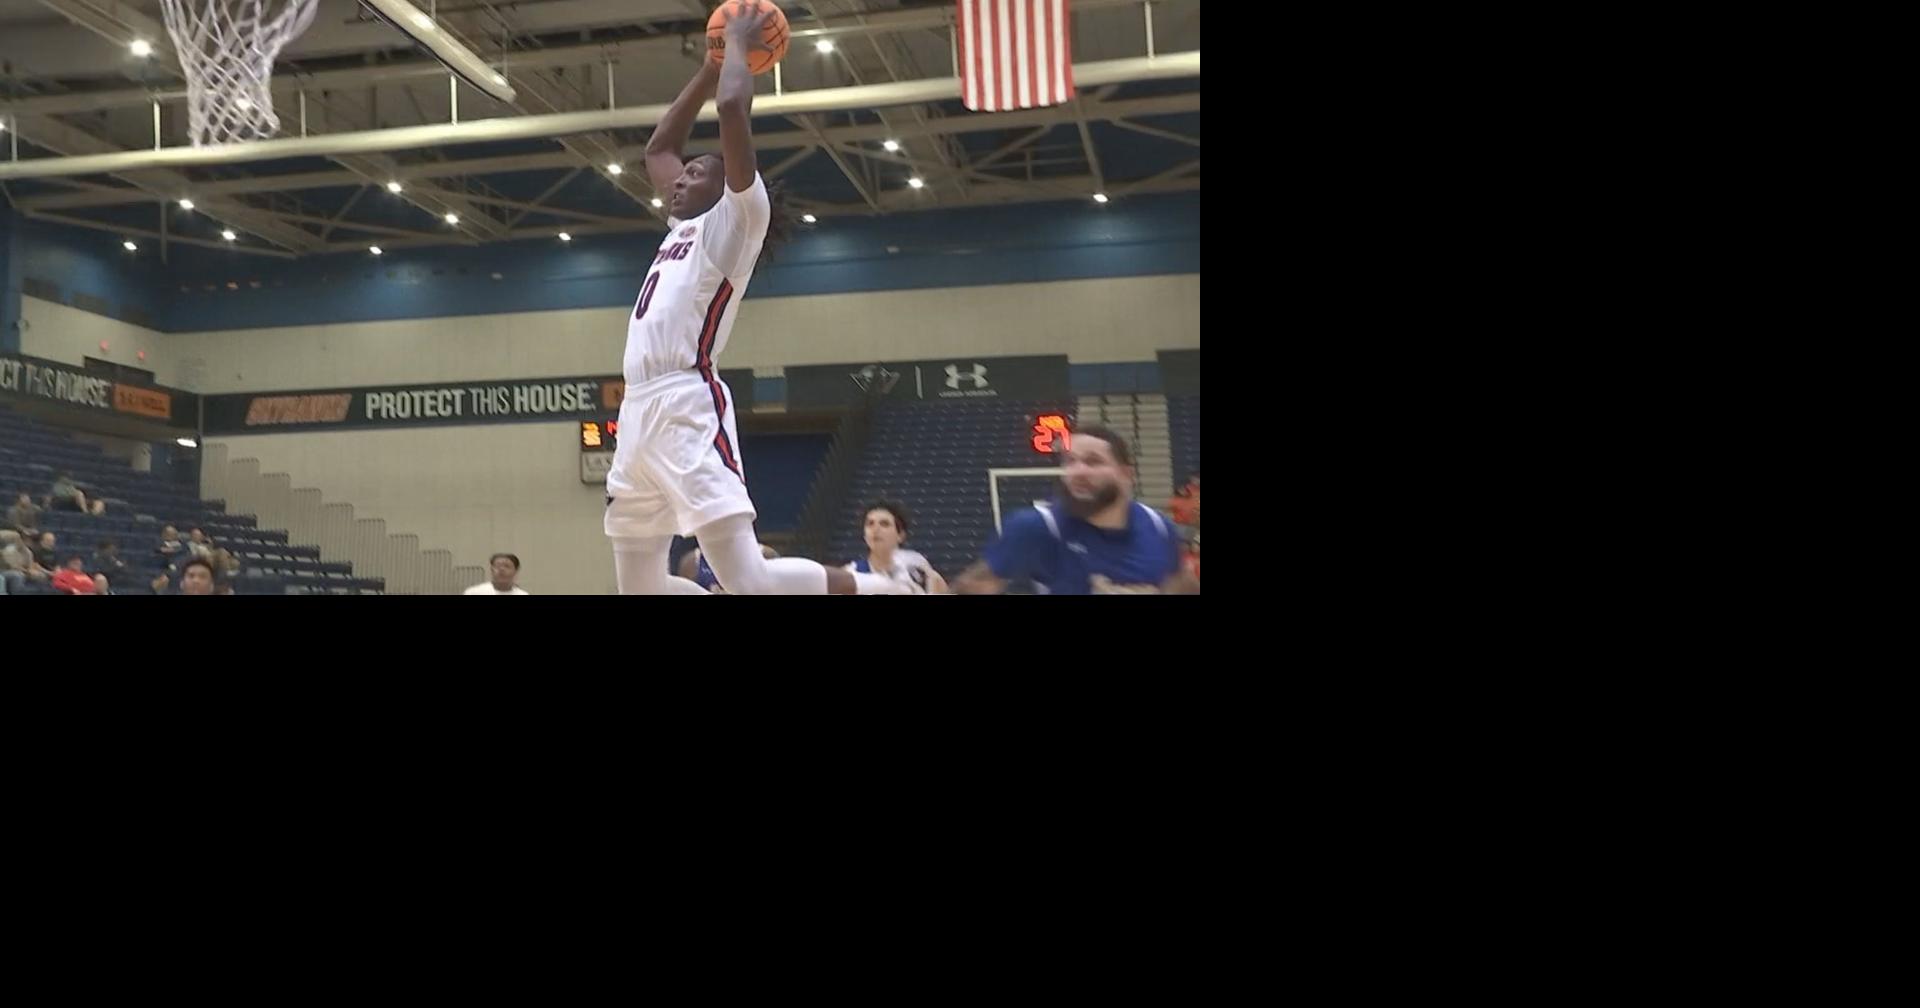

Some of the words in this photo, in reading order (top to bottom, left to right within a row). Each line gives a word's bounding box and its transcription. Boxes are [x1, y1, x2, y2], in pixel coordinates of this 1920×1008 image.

[636, 271, 660, 320] 0
[365, 389, 466, 420] PROTECT
[468, 386, 510, 416] THIS
